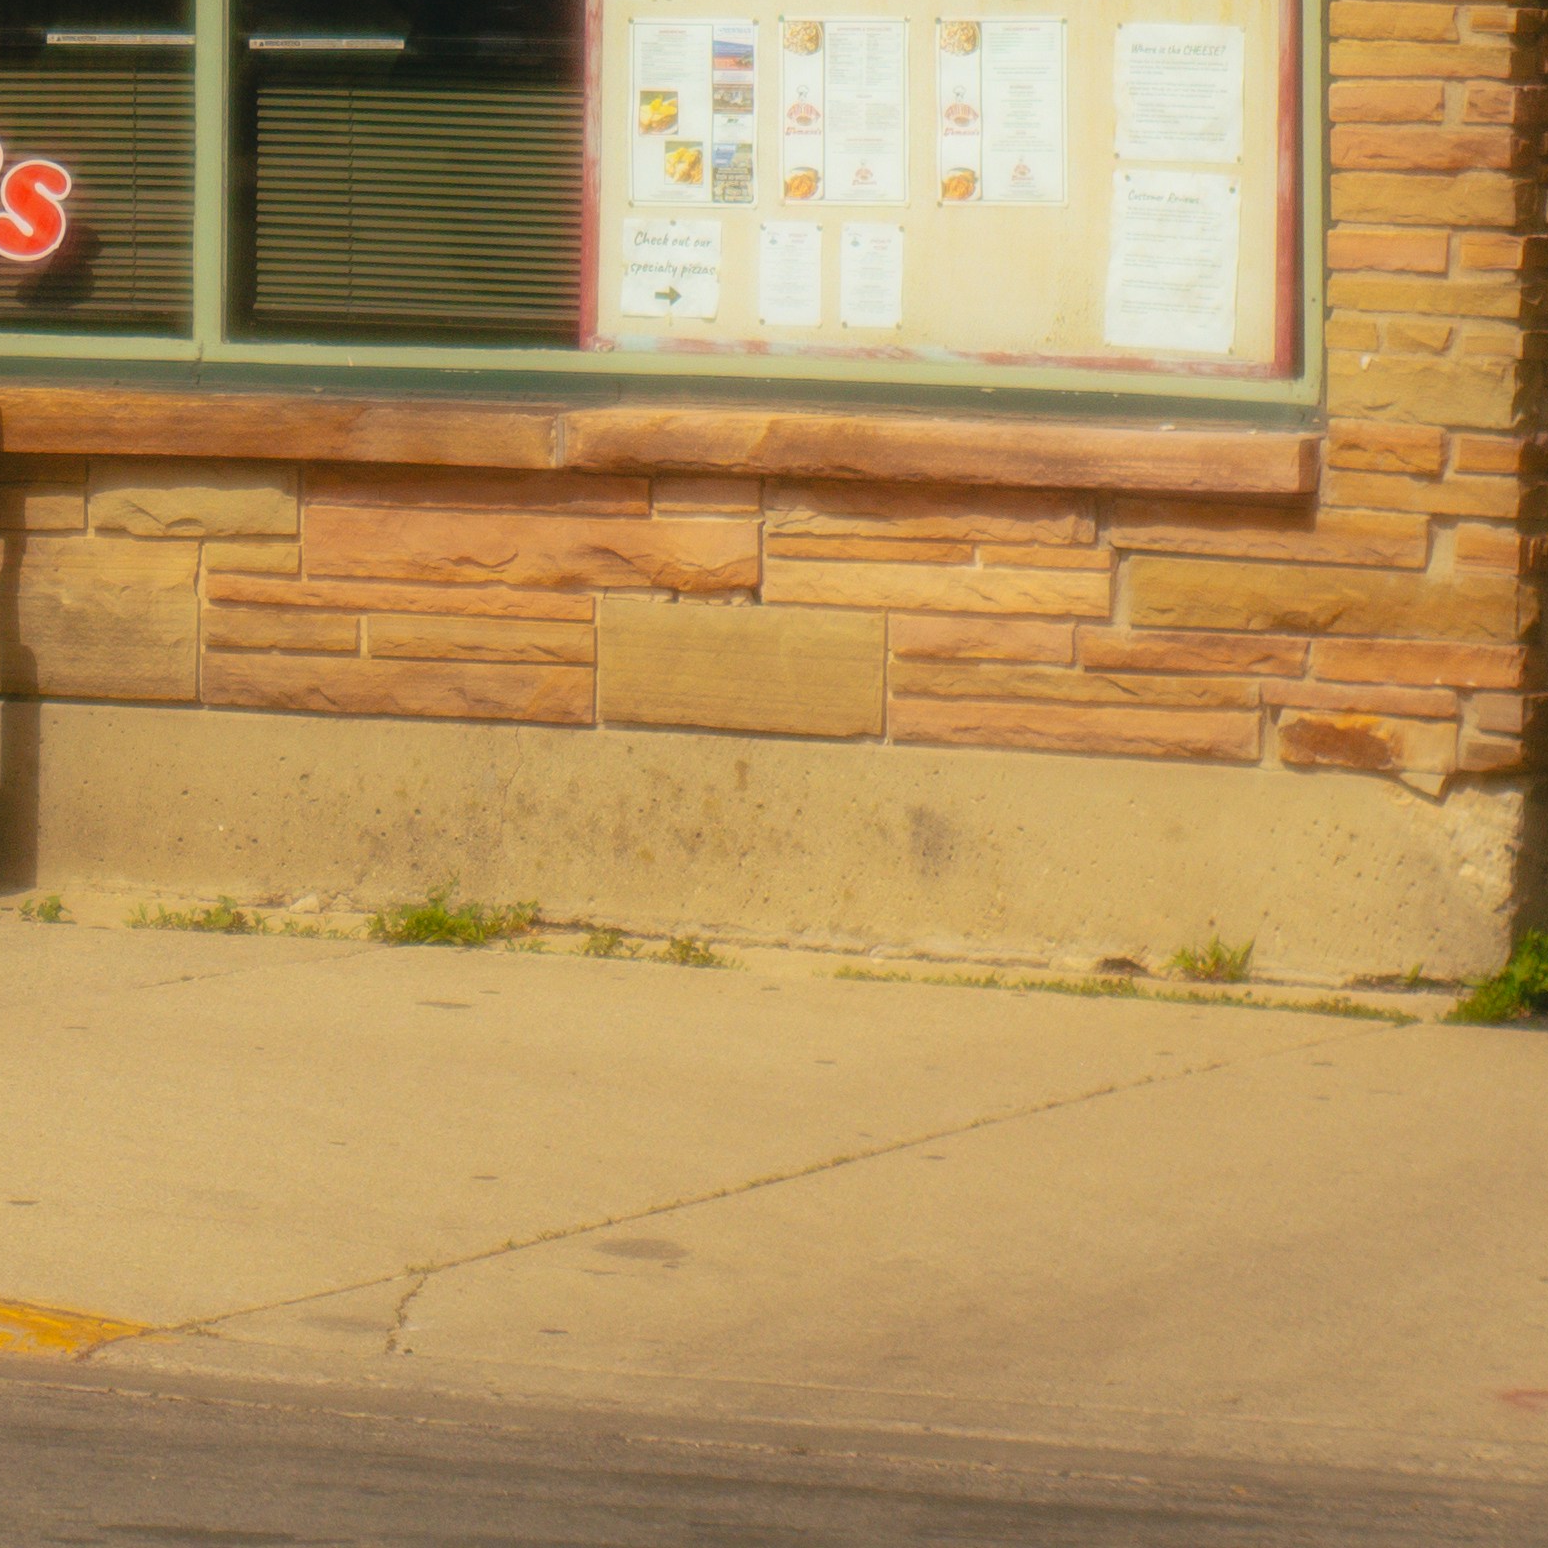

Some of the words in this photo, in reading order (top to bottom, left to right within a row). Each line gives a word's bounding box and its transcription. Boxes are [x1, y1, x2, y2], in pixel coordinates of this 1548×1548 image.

[634, 230, 669, 246] Check
[671, 236, 691, 247] out
[693, 239, 712, 248] our
[630, 260, 679, 278] specialty
[680, 263, 716, 279] pizzas
